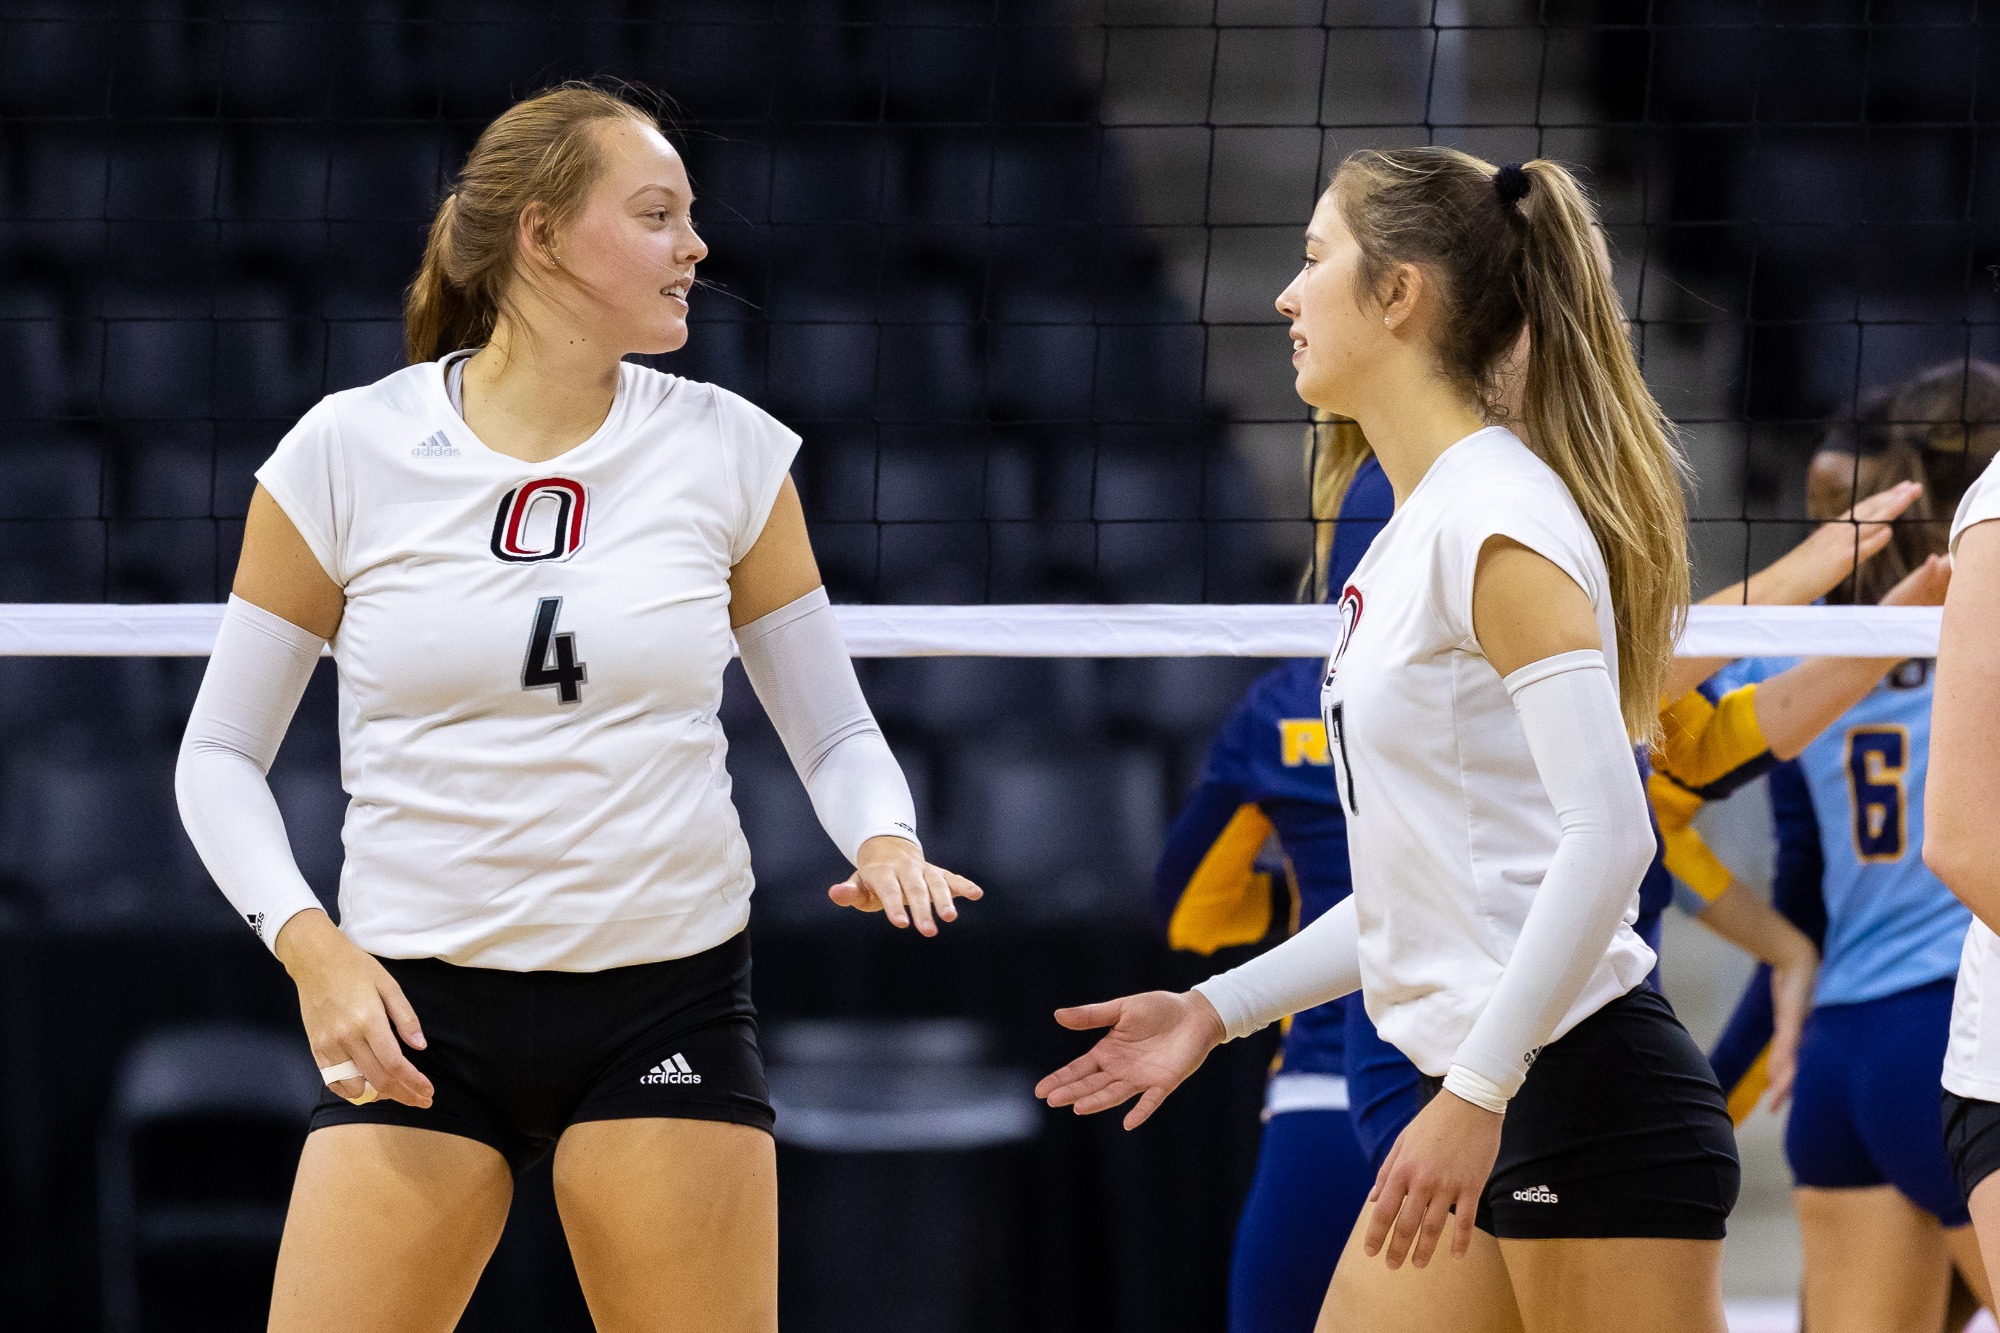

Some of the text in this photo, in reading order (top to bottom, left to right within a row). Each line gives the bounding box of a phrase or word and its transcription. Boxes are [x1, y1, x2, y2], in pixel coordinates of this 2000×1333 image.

[411, 446, 460, 457] adidas
[521, 596, 588, 705] 4
[1844, 723, 1910, 864] 6
[640, 1072, 702, 1084] adidas
[1513, 1189, 1559, 1204] adidas
